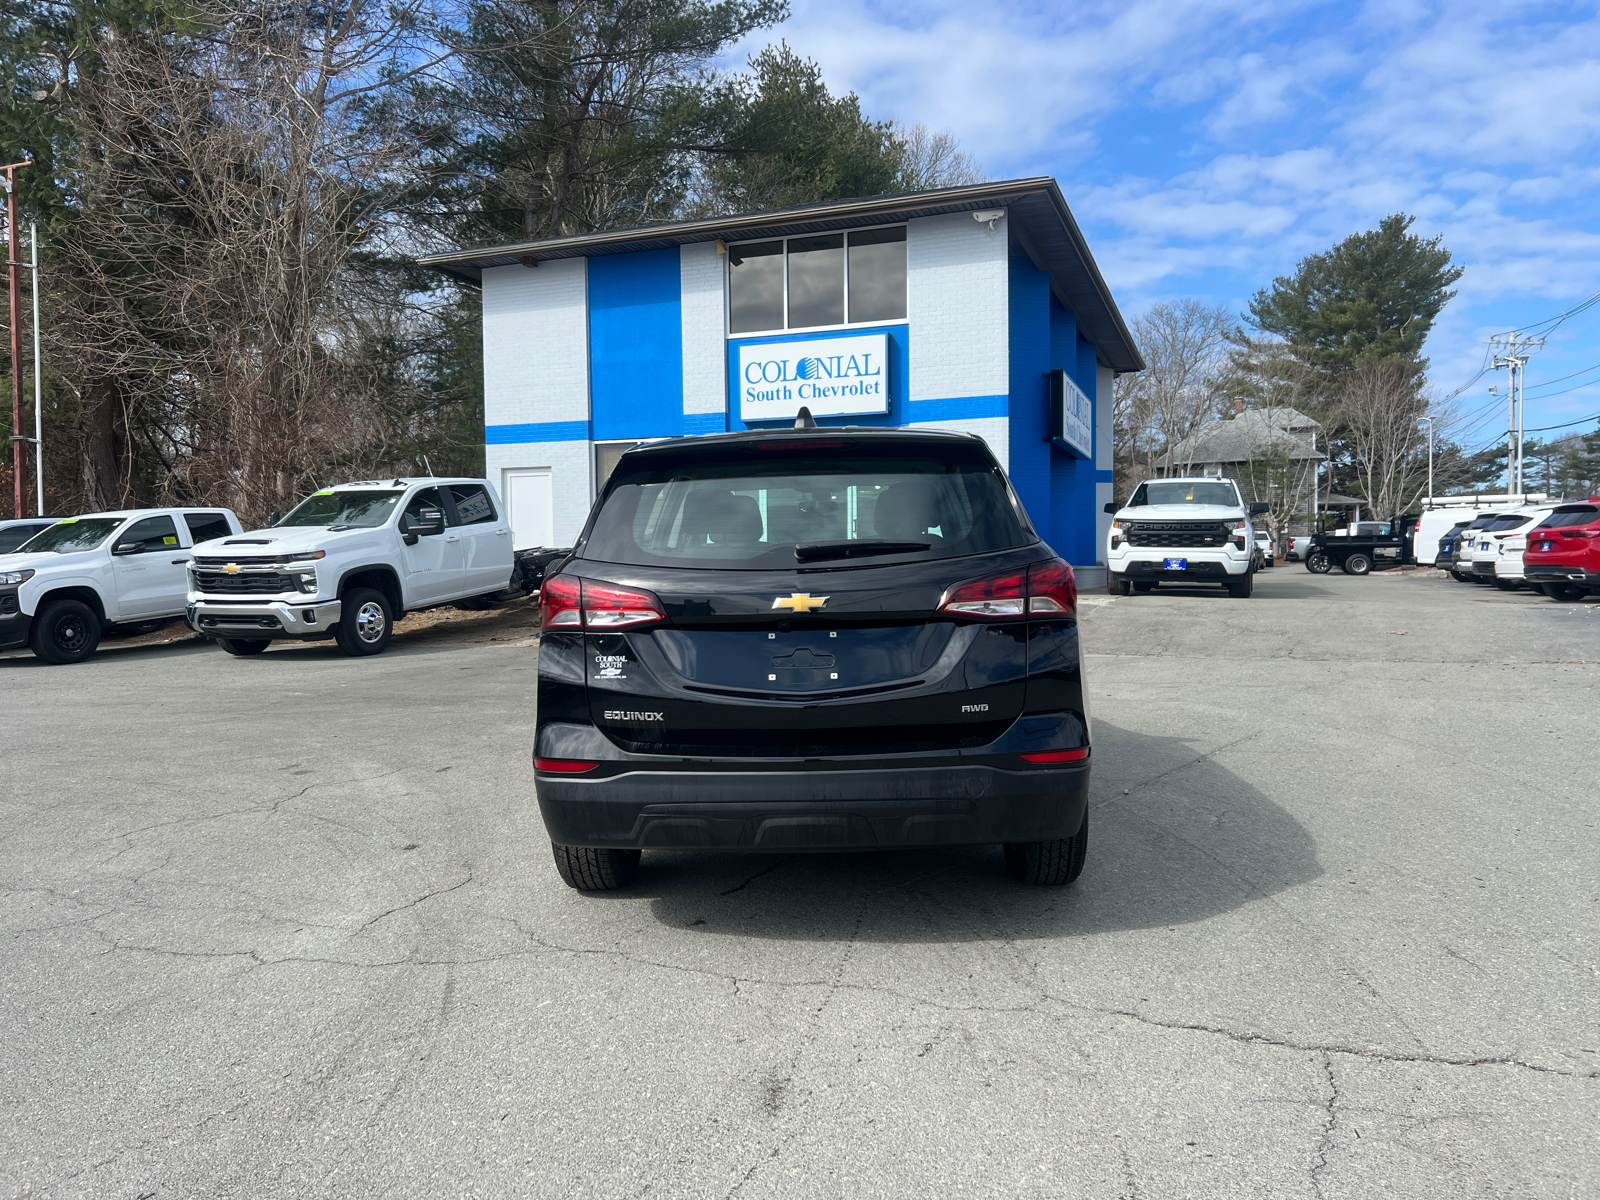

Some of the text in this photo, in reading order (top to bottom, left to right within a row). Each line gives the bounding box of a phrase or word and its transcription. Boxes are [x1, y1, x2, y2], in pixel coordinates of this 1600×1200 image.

[745, 353, 881, 385] COLONIAL
[746, 380, 881, 402] South Chevrolet
[595, 655, 628, 663] COLONIAL
[961, 703, 989, 713] AWD
[603, 710, 664, 721] EQUINOX
